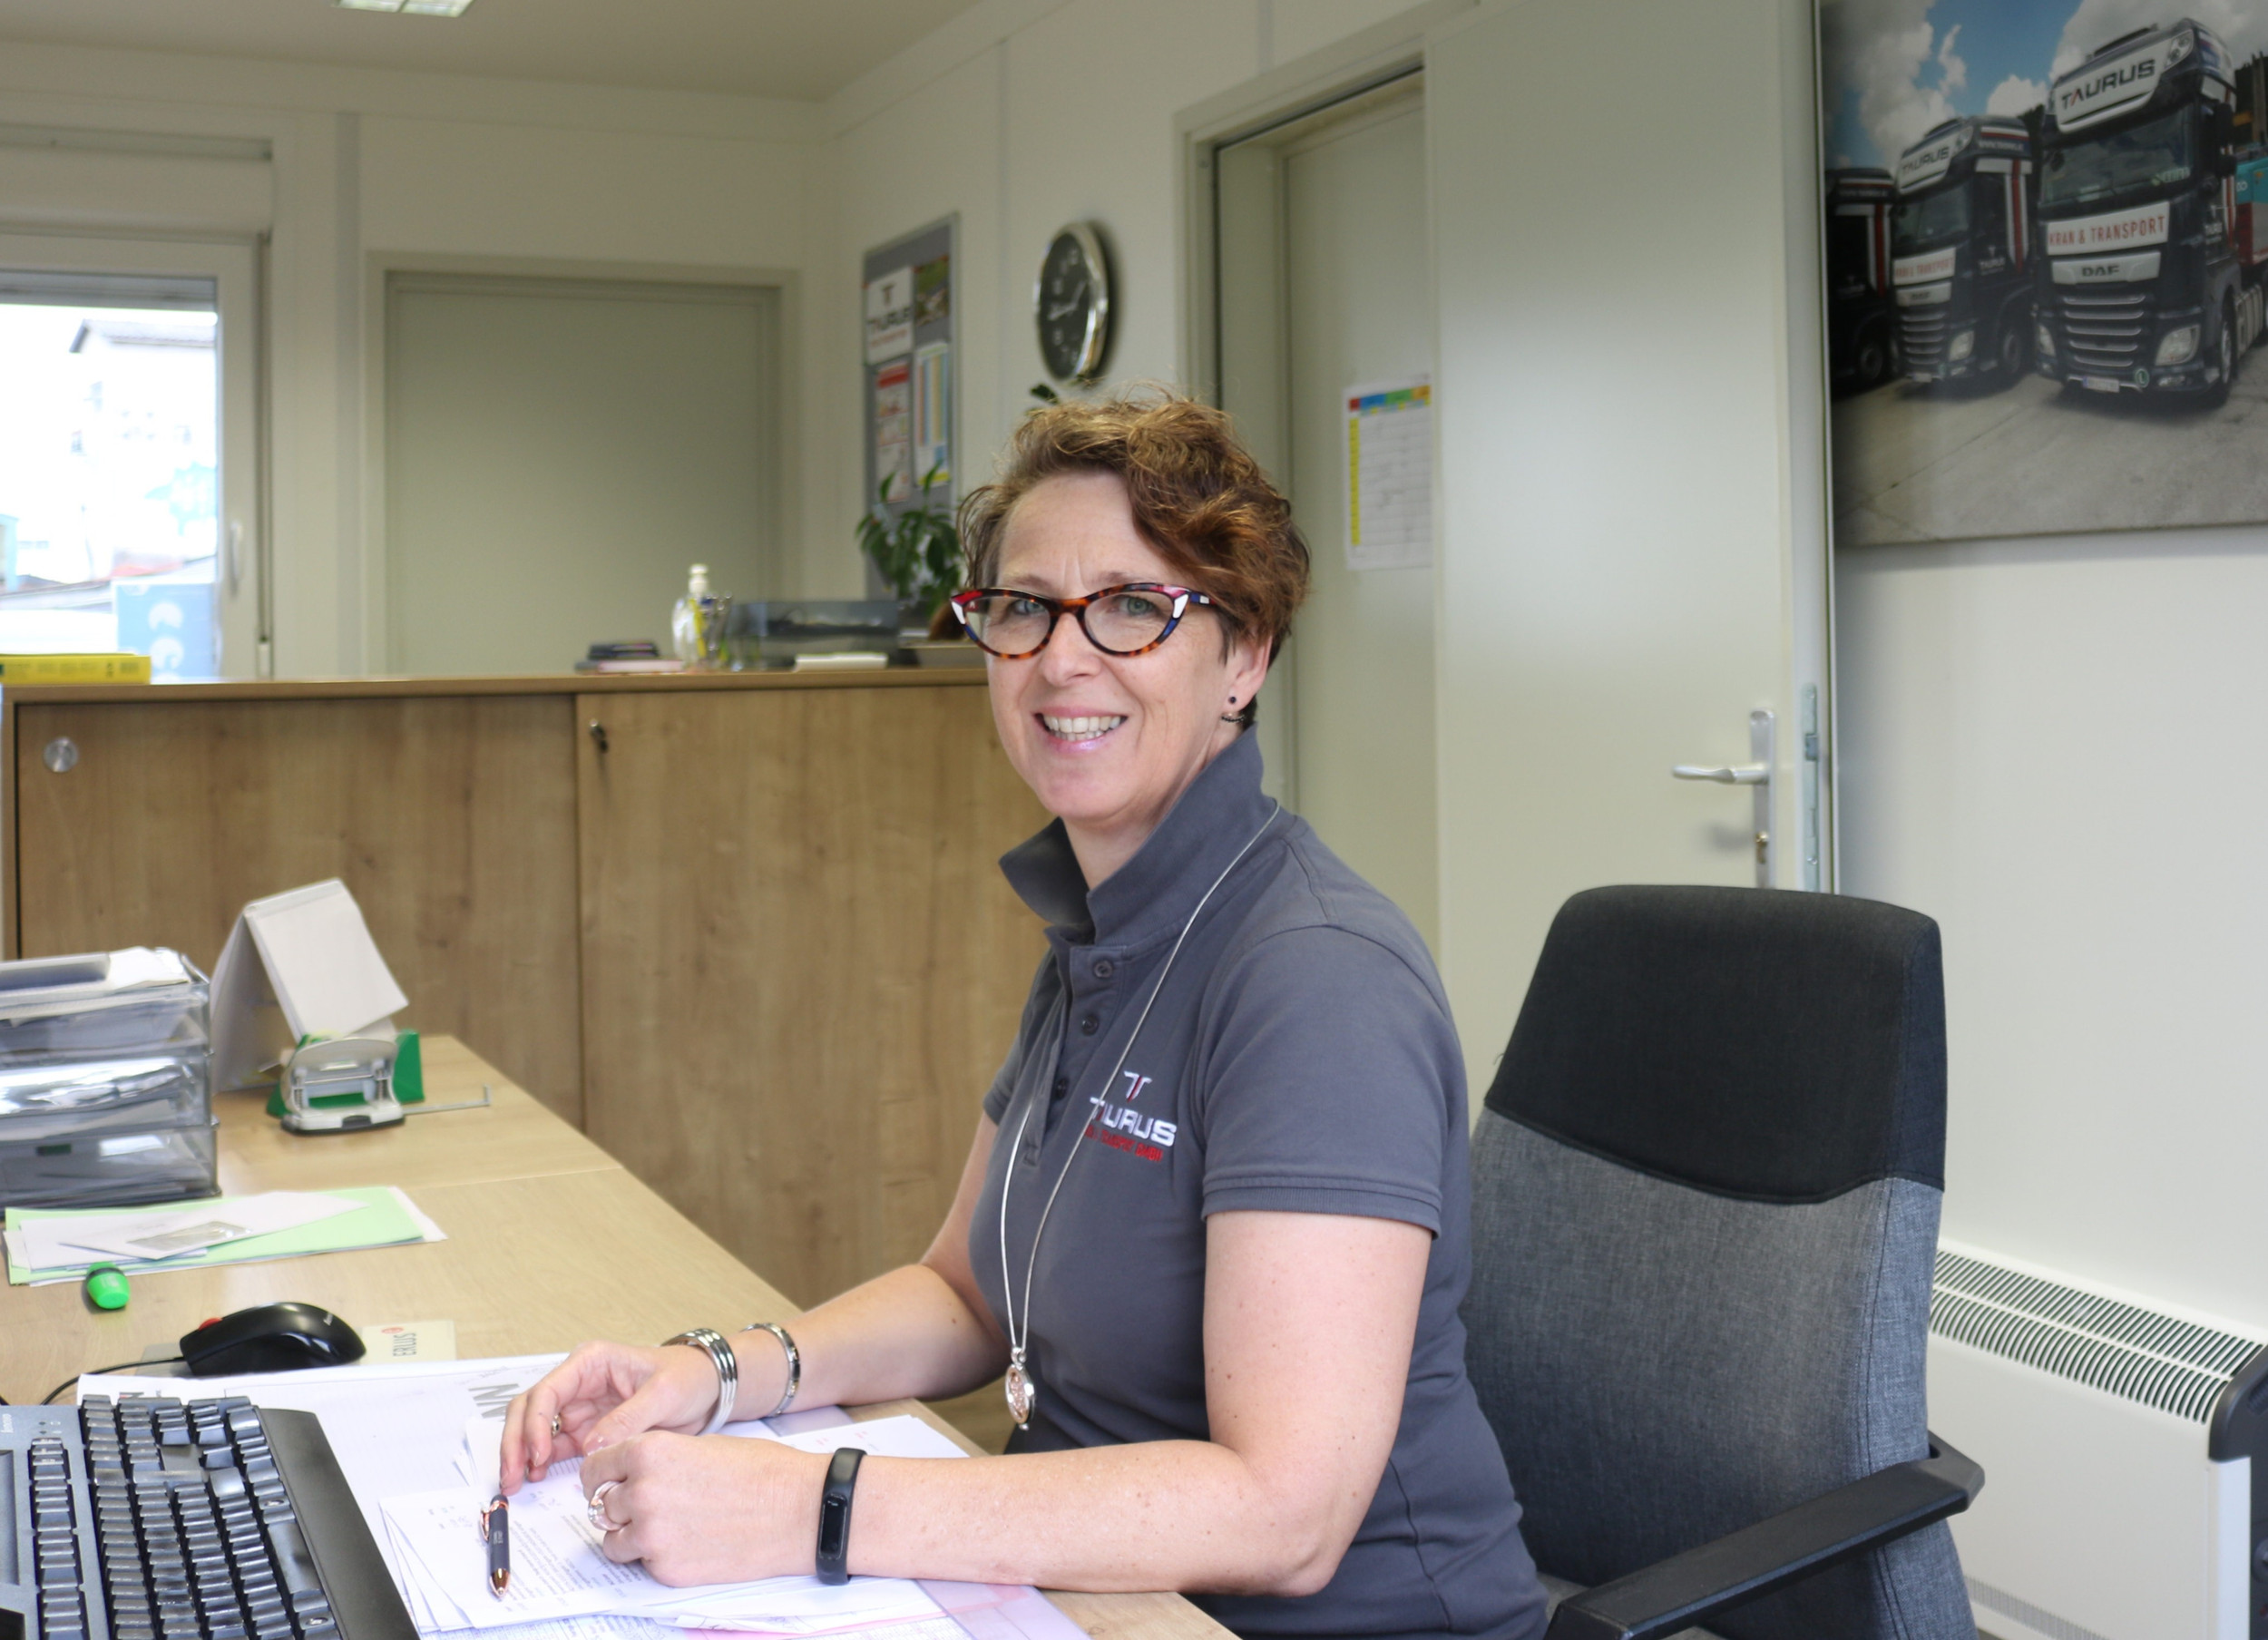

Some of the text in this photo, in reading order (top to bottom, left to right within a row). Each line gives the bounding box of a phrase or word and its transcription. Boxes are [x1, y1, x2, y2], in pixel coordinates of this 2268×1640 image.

[2061, 59, 2156, 110] TAURUS
[2089, 215, 2165, 243] TRANSPORT
[2080, 264, 2120, 278] DAF
[1090, 1096, 1178, 1147] TAURUS
[393, 1332, 416, 1356] ERLUS
